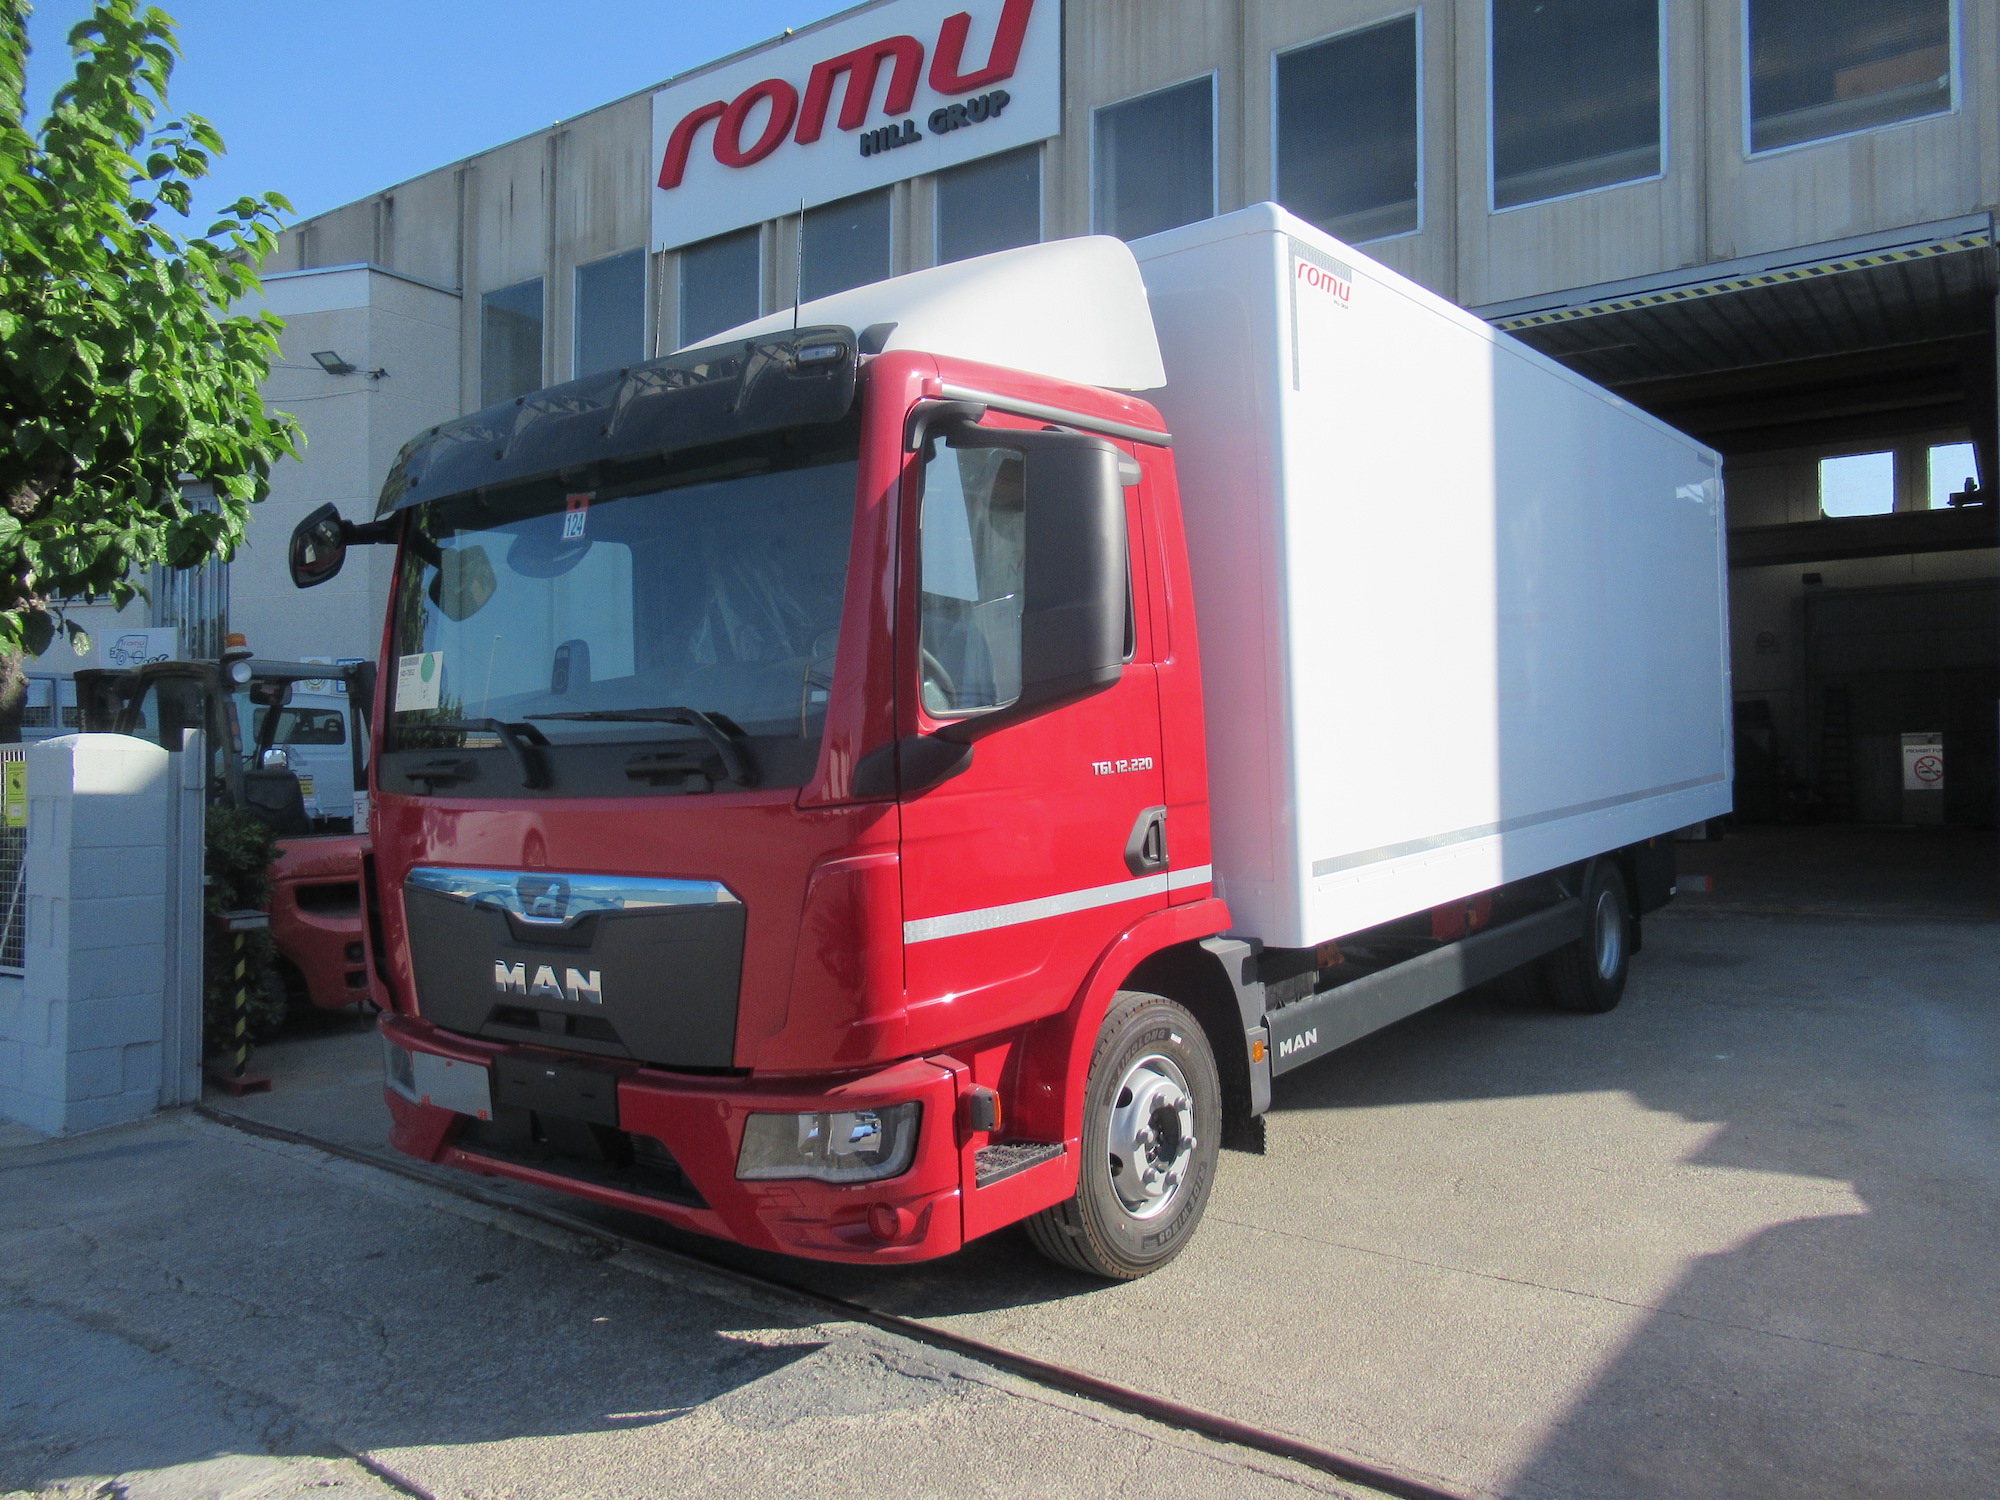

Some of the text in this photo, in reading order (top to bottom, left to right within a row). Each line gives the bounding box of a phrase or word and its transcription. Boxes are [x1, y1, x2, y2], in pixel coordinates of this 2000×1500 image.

[657, 0, 1034, 190] romu
[859, 89, 1011, 158] HILL GRUP
[1297, 262, 1350, 302] romu
[566, 512, 584, 537] 124
[1091, 756, 1154, 776] TGL 12.220
[494, 958, 603, 1005] MAN
[1279, 1027, 1318, 1058] MAN
